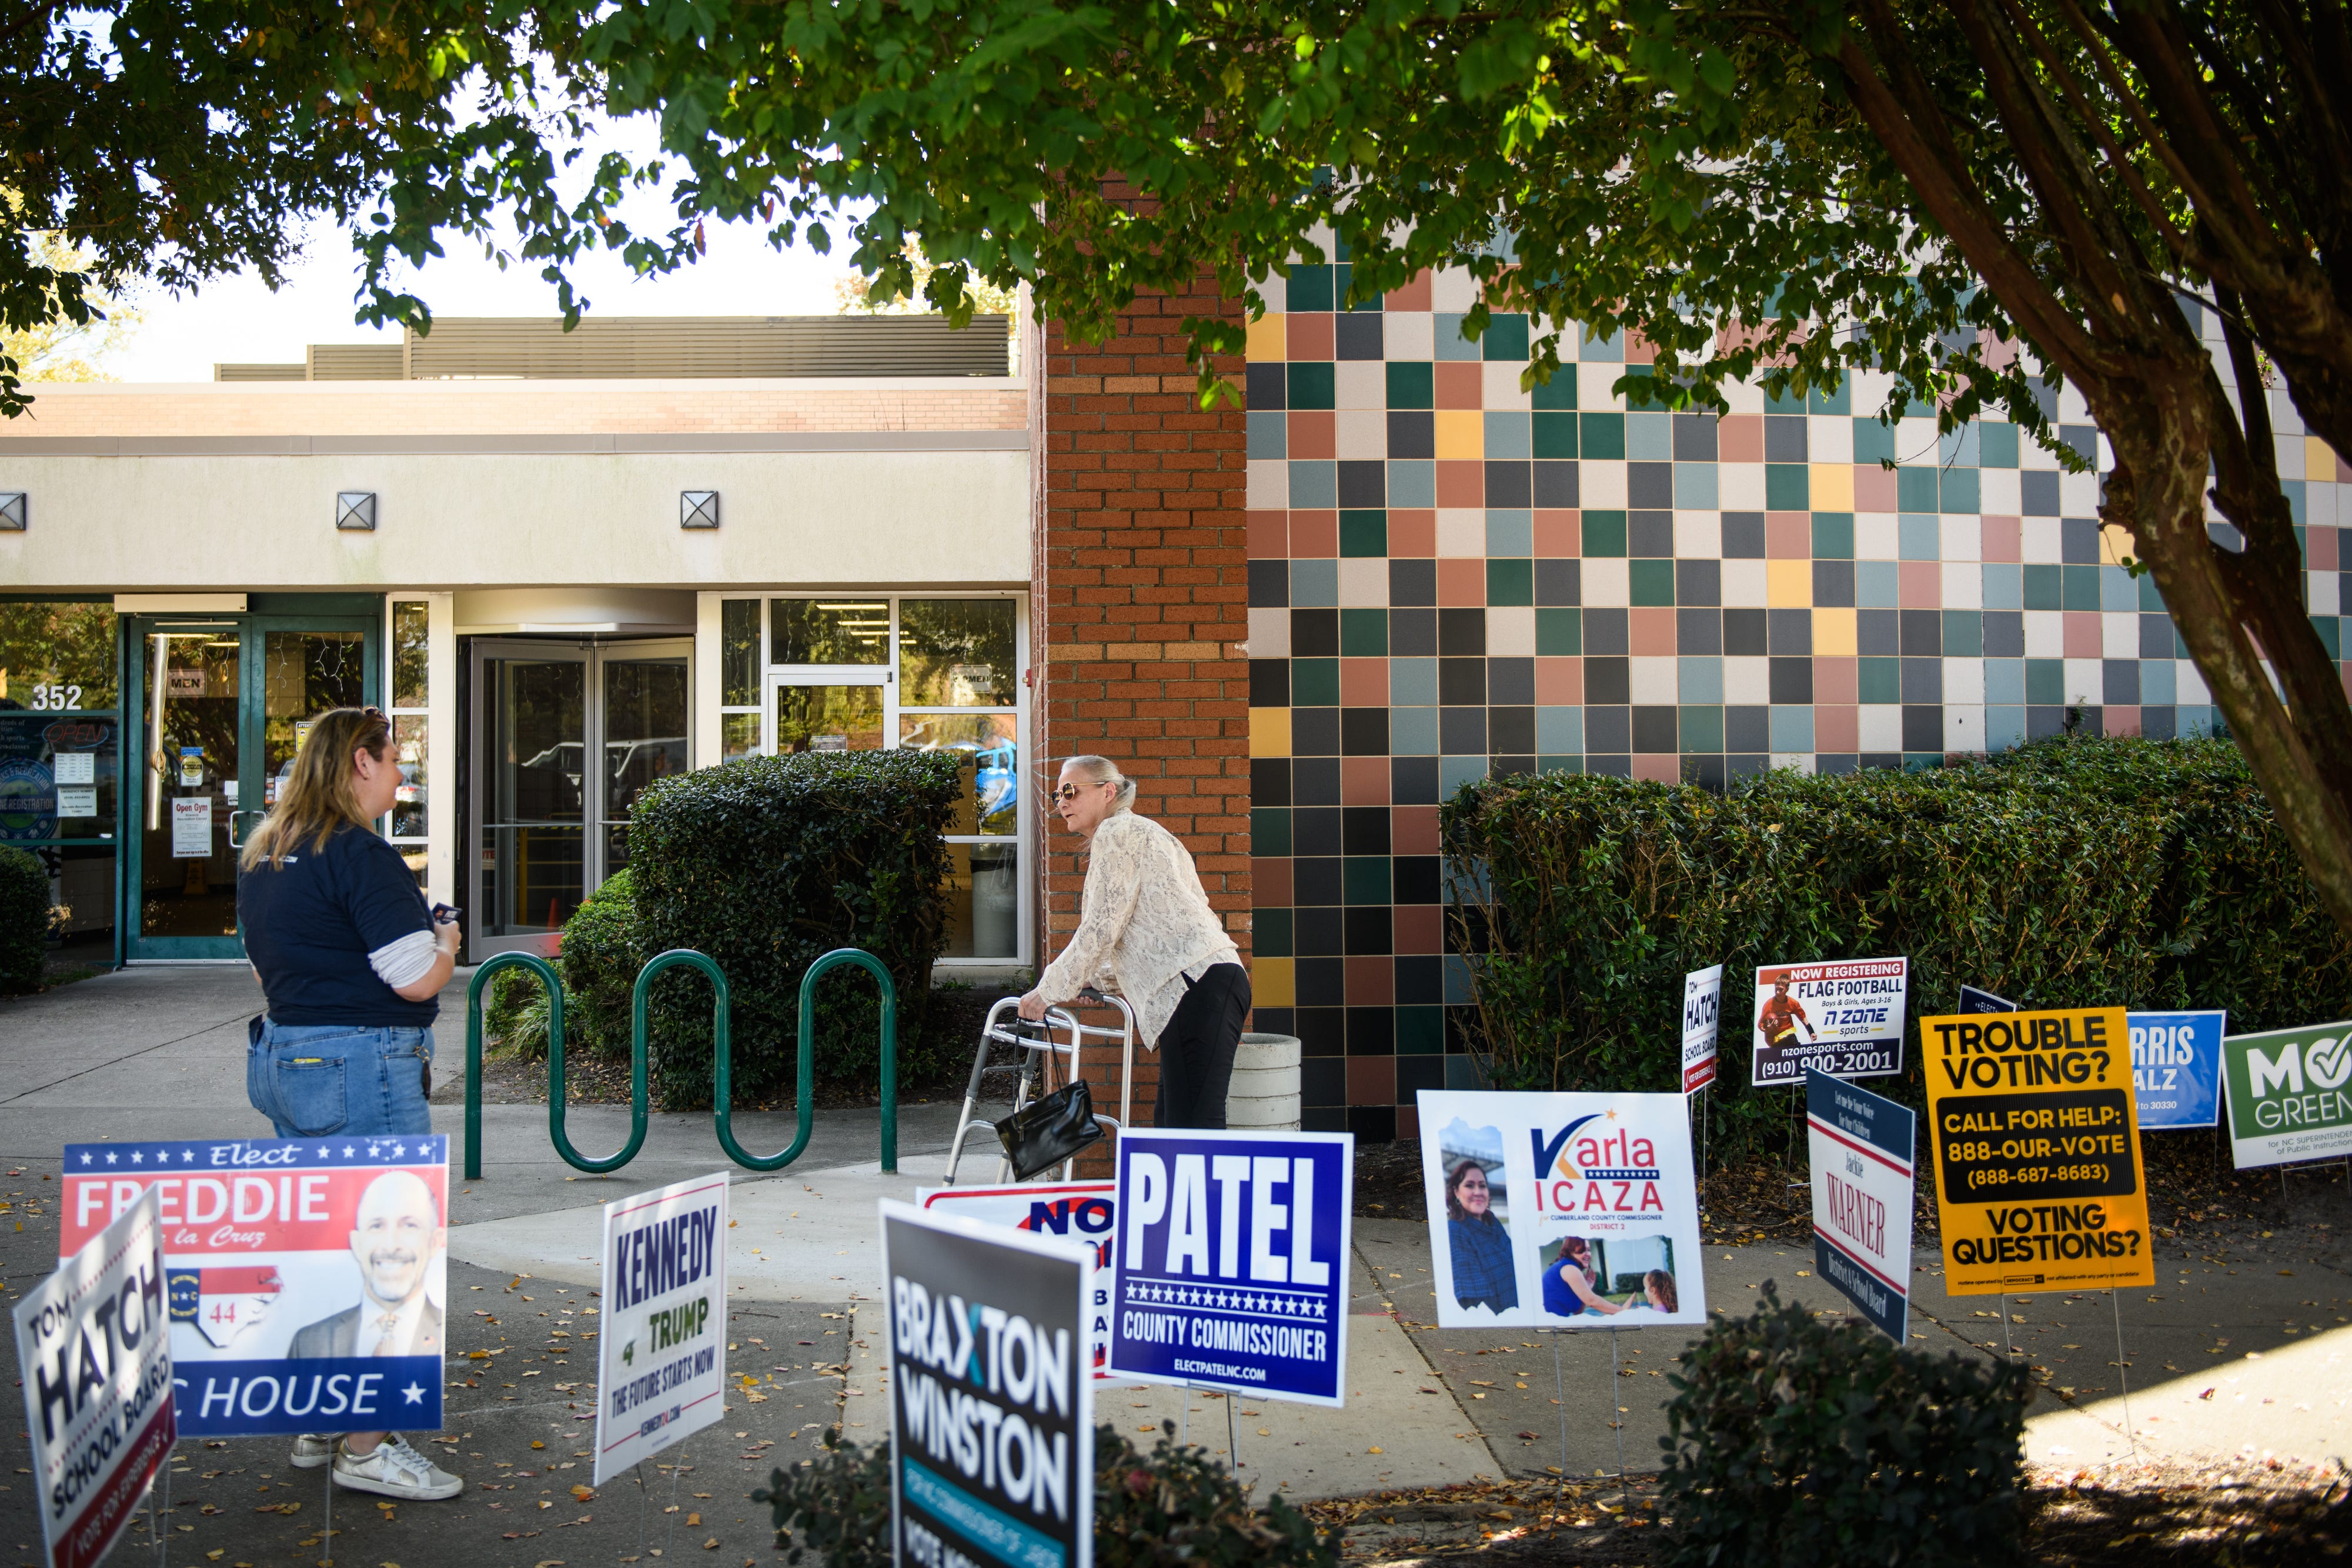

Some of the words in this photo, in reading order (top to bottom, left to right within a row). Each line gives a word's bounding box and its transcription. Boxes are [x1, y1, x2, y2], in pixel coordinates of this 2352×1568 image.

[172, 678, 200, 688] MEN
[33, 685, 82, 710] 352
[48, 724, 103, 743] OPEN
[15, 766, 51, 791] RECREATION
[9, 798, 54, 810] REGISTRATION
[176, 803, 192, 813] Open
[194, 803, 208, 813] Gym
[1790, 967, 1822, 981] NOW
[1825, 963, 1901, 978] REGISTERING
[1688, 979, 1698, 994] TOM
[1798, 981, 1833, 998] FLAG
[1837, 978, 1902, 996] FOOTBALL
[1686, 991, 1718, 1032] HATCH
[1844, 998, 1859, 1006] Girls,
[1980, 1001, 1996, 1014] ELECT
[1839, 1025, 1869, 1037] sports
[1933, 1015, 2108, 1056] TROUBLE
[1685, 1044, 1702, 1062] SCHOOL
[1702, 1035, 1715, 1054] BOARD
[1781, 1041, 1873, 1057] nzonesports.com
[2129, 1026, 2194, 1065] RRIS
[1699, 1064, 1711, 1079] EXPERIENCE
[1762, 1060, 1795, 1078] (910)
[1800, 1051, 1892, 1075] 900-2001
[1940, 1049, 2111, 1090] VOTING?
[2133, 1068, 2177, 1091] ALZ
[2150, 1101, 2177, 1109] 30330
[1944, 1109, 2003, 1133] CALL
[2007, 1109, 2055, 1131] FOR
[2058, 1108, 2122, 1128] HELP:
[1530, 1114, 1656, 1180] Karla
[1947, 1134, 2125, 1162] 888-OUR-VOTE
[2281, 1138, 2294, 1147] NC
[2297, 1129, 2352, 1144] SUPERINTENDE
[2287, 1145, 2311, 1154] Public
[2313, 1139, 2352, 1150] Instruction
[209, 1143, 303, 1165] Elect
[1845, 1151, 1863, 1178] Jackie
[1967, 1162, 2110, 1190] (888-687-8683)
[76, 1175, 330, 1228] FREDDIE
[1535, 1179, 1664, 1212] ICAZA
[1125, 1152, 1330, 1286] PATEL
[1826, 1171, 1886, 1260] WARNER
[1985, 1202, 2106, 1235] VOTING
[174, 1228, 199, 1245] la
[208, 1224, 266, 1249] Cruz
[1952, 1229, 2141, 1266] QUESTIONS?
[615, 1205, 718, 1313] KENNEDY
[29, 1295, 72, 1349] TOM
[209, 1302, 235, 1324] 44
[648, 1296, 710, 1353] TRUMP
[36, 1248, 163, 1446] HATCH
[893, 1275, 1071, 1419] BRAXTON
[1122, 1310, 1188, 1346] COUNTY
[1191, 1317, 1327, 1363] COMMISSIONER
[622, 1338, 636, 1367] 4
[612, 1385, 628, 1419] THE
[629, 1369, 661, 1410] FUTURE
[662, 1355, 693, 1393] STARTS
[694, 1345, 715, 1378] NOW
[1174, 1358, 1267, 1382] ELECTPATELNC.COM
[201, 1373, 383, 1418] HOUSE
[640, 1403, 681, 1438] KENNEDY24.COM
[53, 1416, 121, 1520] SCHOOL
[123, 1353, 169, 1433] BOARD
[898, 1362, 1070, 1523] WINSTON
